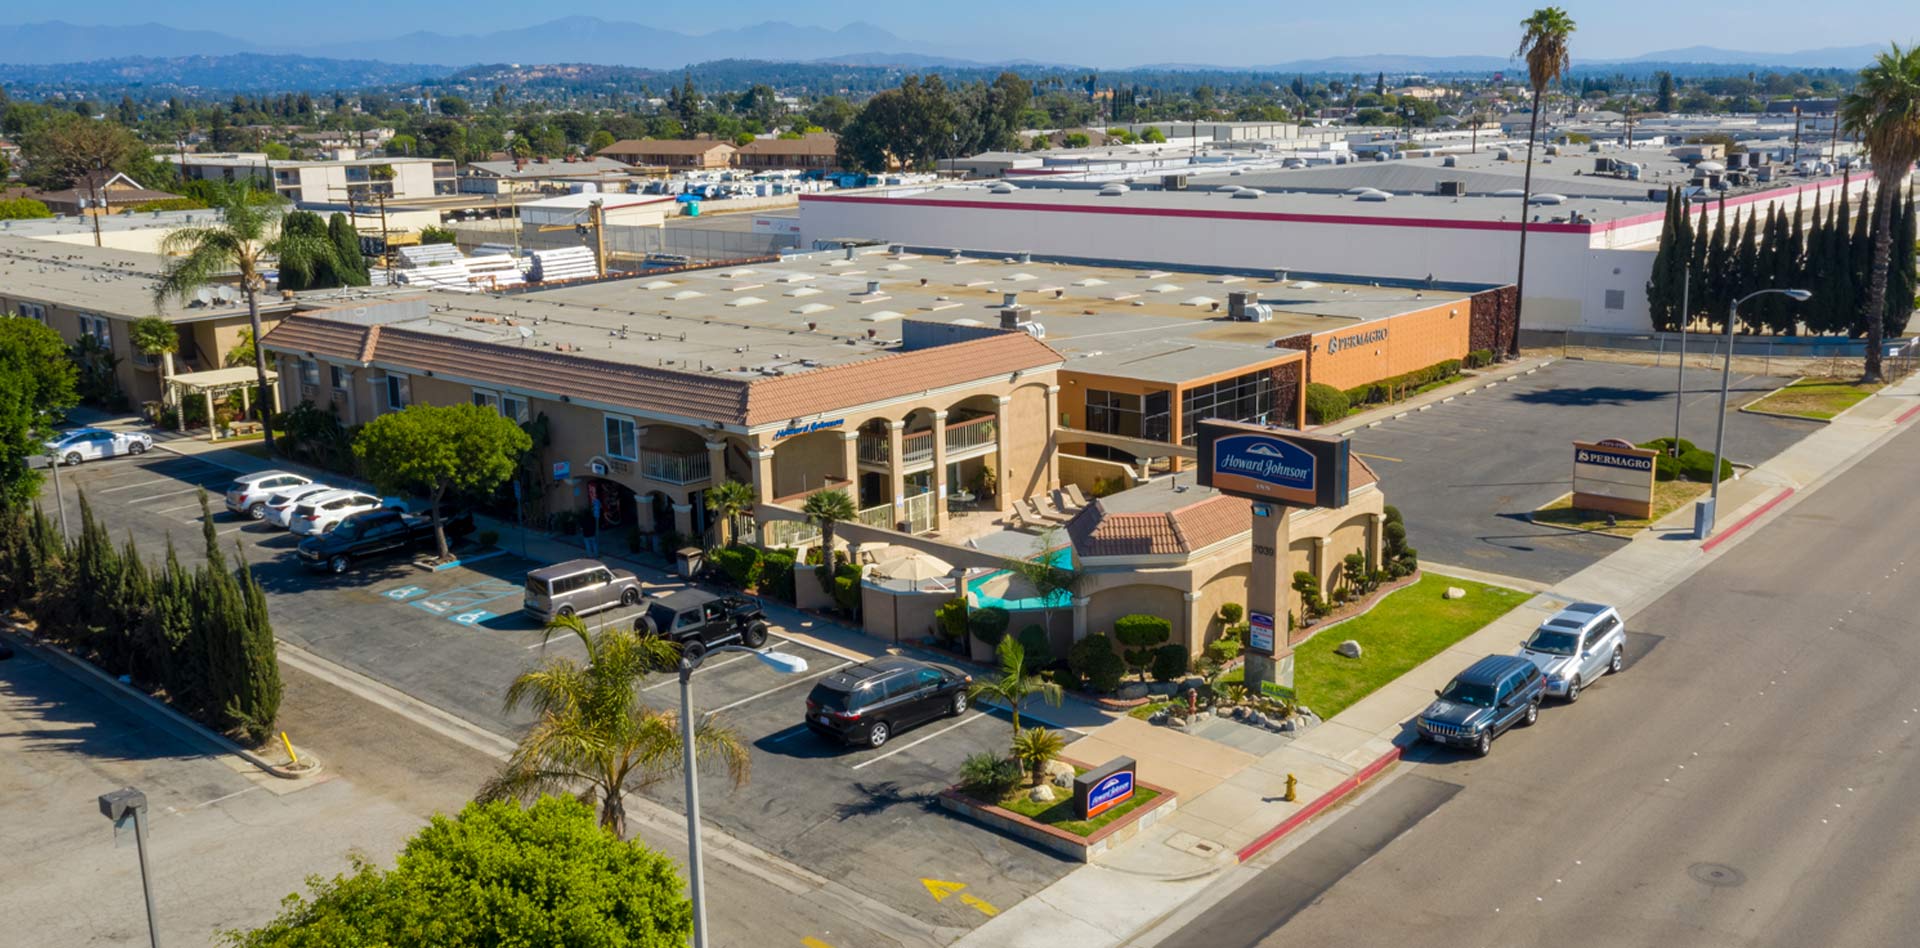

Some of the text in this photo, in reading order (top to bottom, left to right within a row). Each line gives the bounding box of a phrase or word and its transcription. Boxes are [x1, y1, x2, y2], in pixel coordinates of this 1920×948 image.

[1338, 328, 1388, 351] PERMAGRO
[1221, 454, 1308, 478] Howard Johnson
[1590, 453, 1651, 469] PERMAGRO
[1254, 544, 1274, 556] 7039
